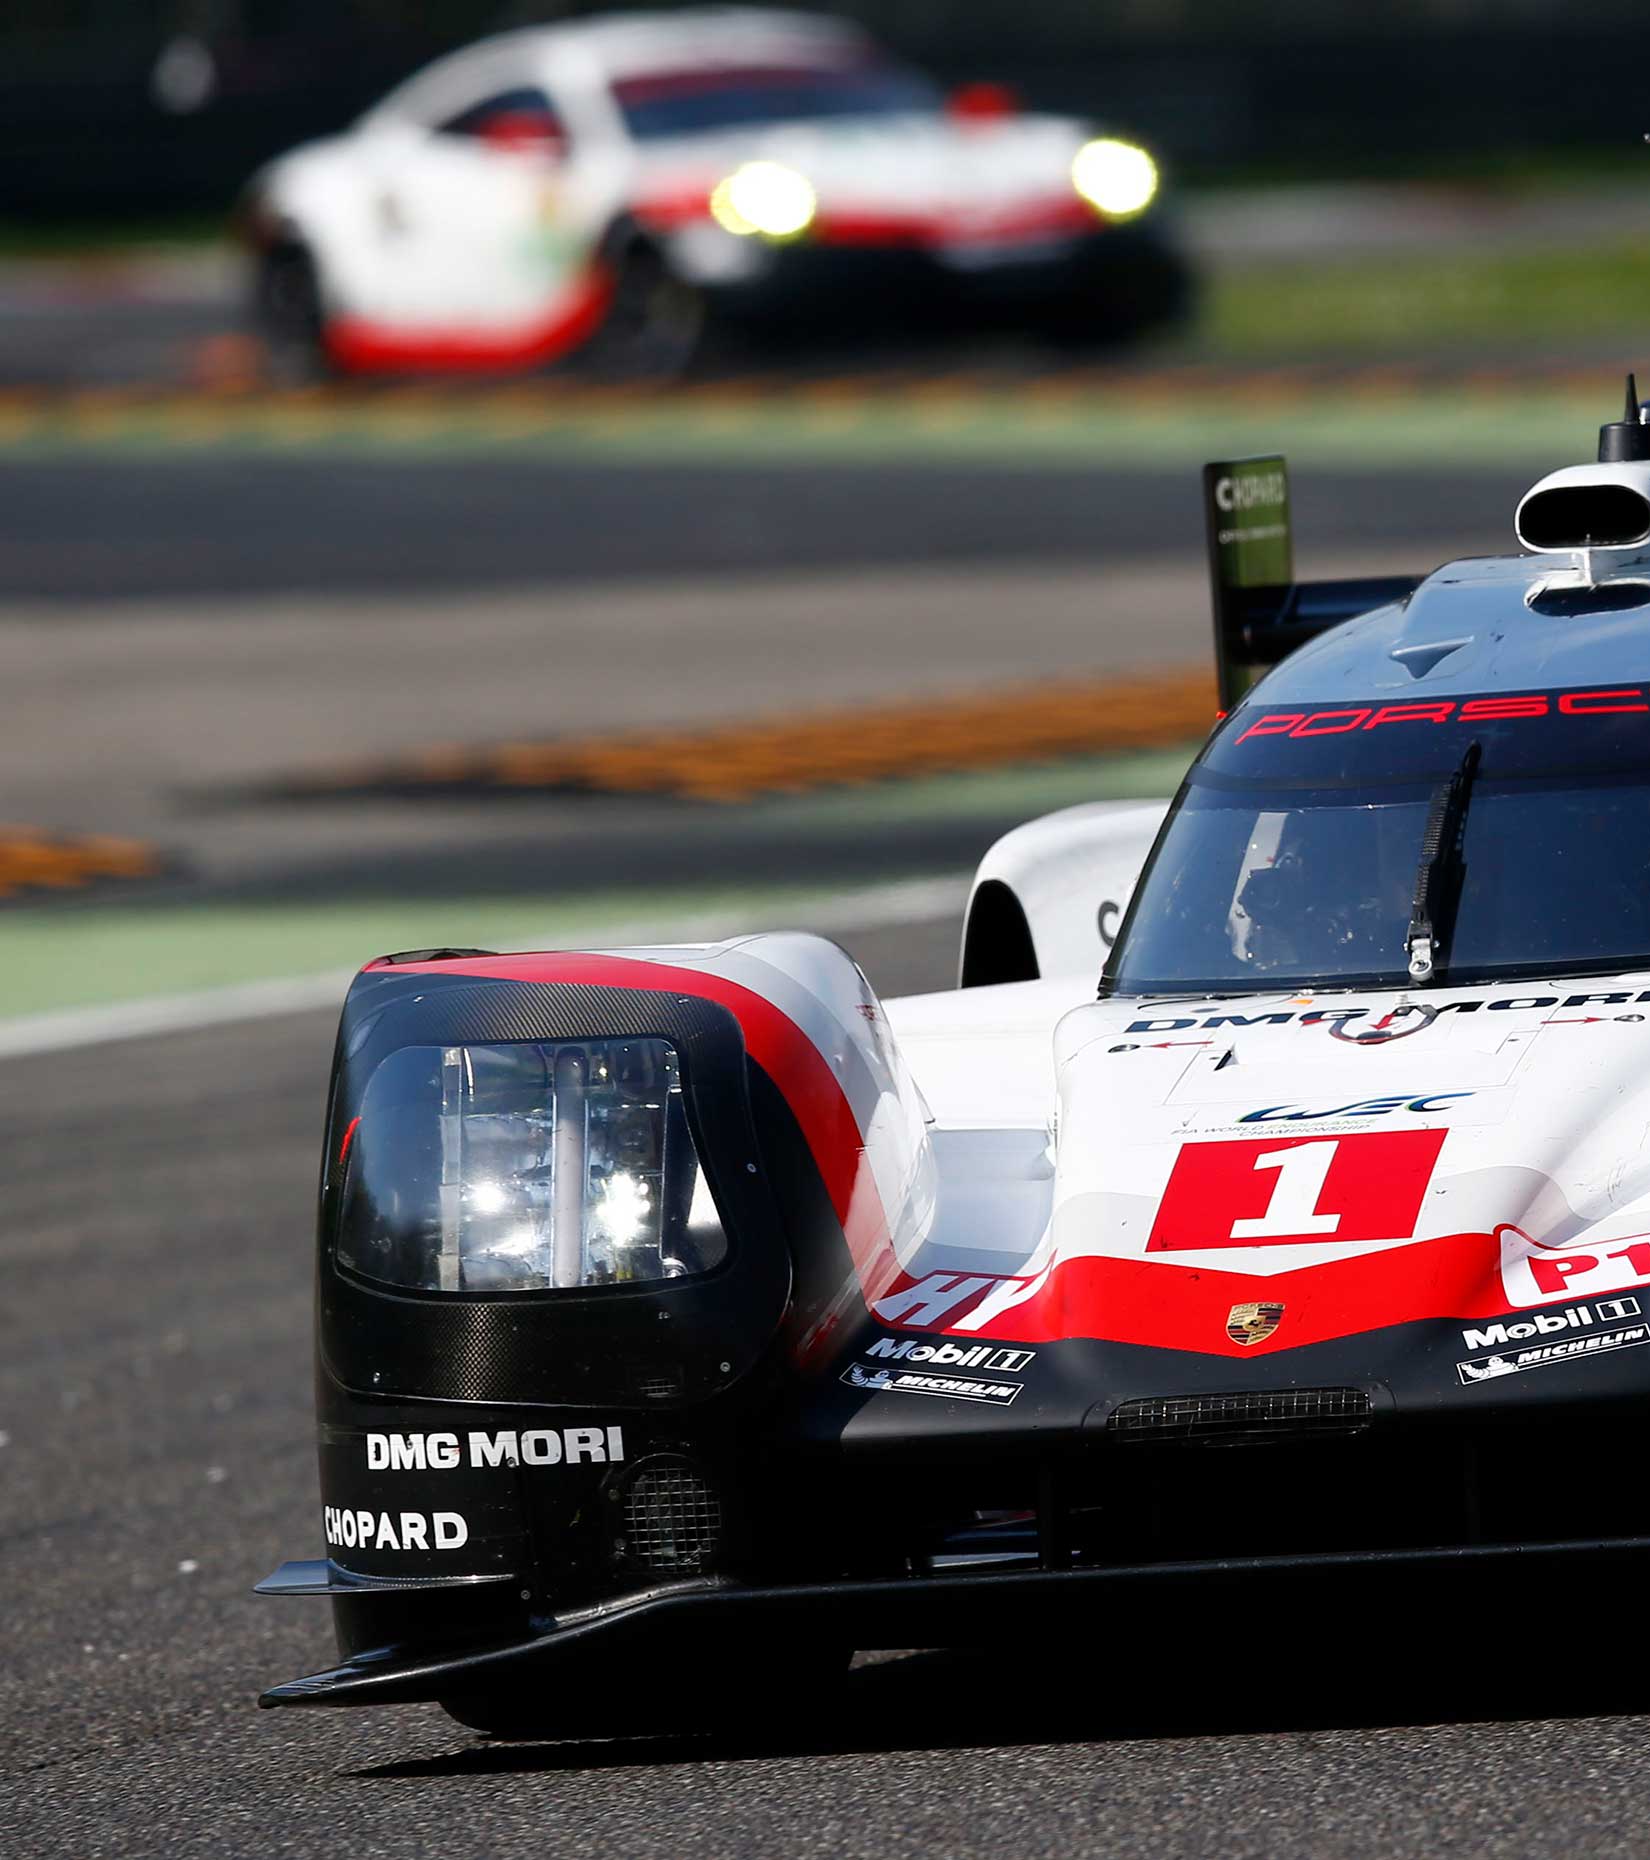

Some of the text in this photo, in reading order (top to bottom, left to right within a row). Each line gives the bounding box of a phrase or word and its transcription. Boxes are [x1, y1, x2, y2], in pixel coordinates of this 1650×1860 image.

[1124, 1009, 1371, 1034] DMG
[1204, 1125, 1264, 1133] WORLD
[1239, 1124, 1371, 1137] CHAMPIONSHIP
[1229, 1140, 1340, 1239] 1
[872, 1264, 1051, 1331] HY
[1462, 1306, 1593, 1350] Mobil
[1517, 1328, 1645, 1364] MICHELIN
[865, 1338, 993, 1367] Mobil
[895, 1375, 1016, 1397] MICHELIN
[366, 1426, 625, 1470] DMG MORI
[324, 1505, 469, 1551] CHOPARD
